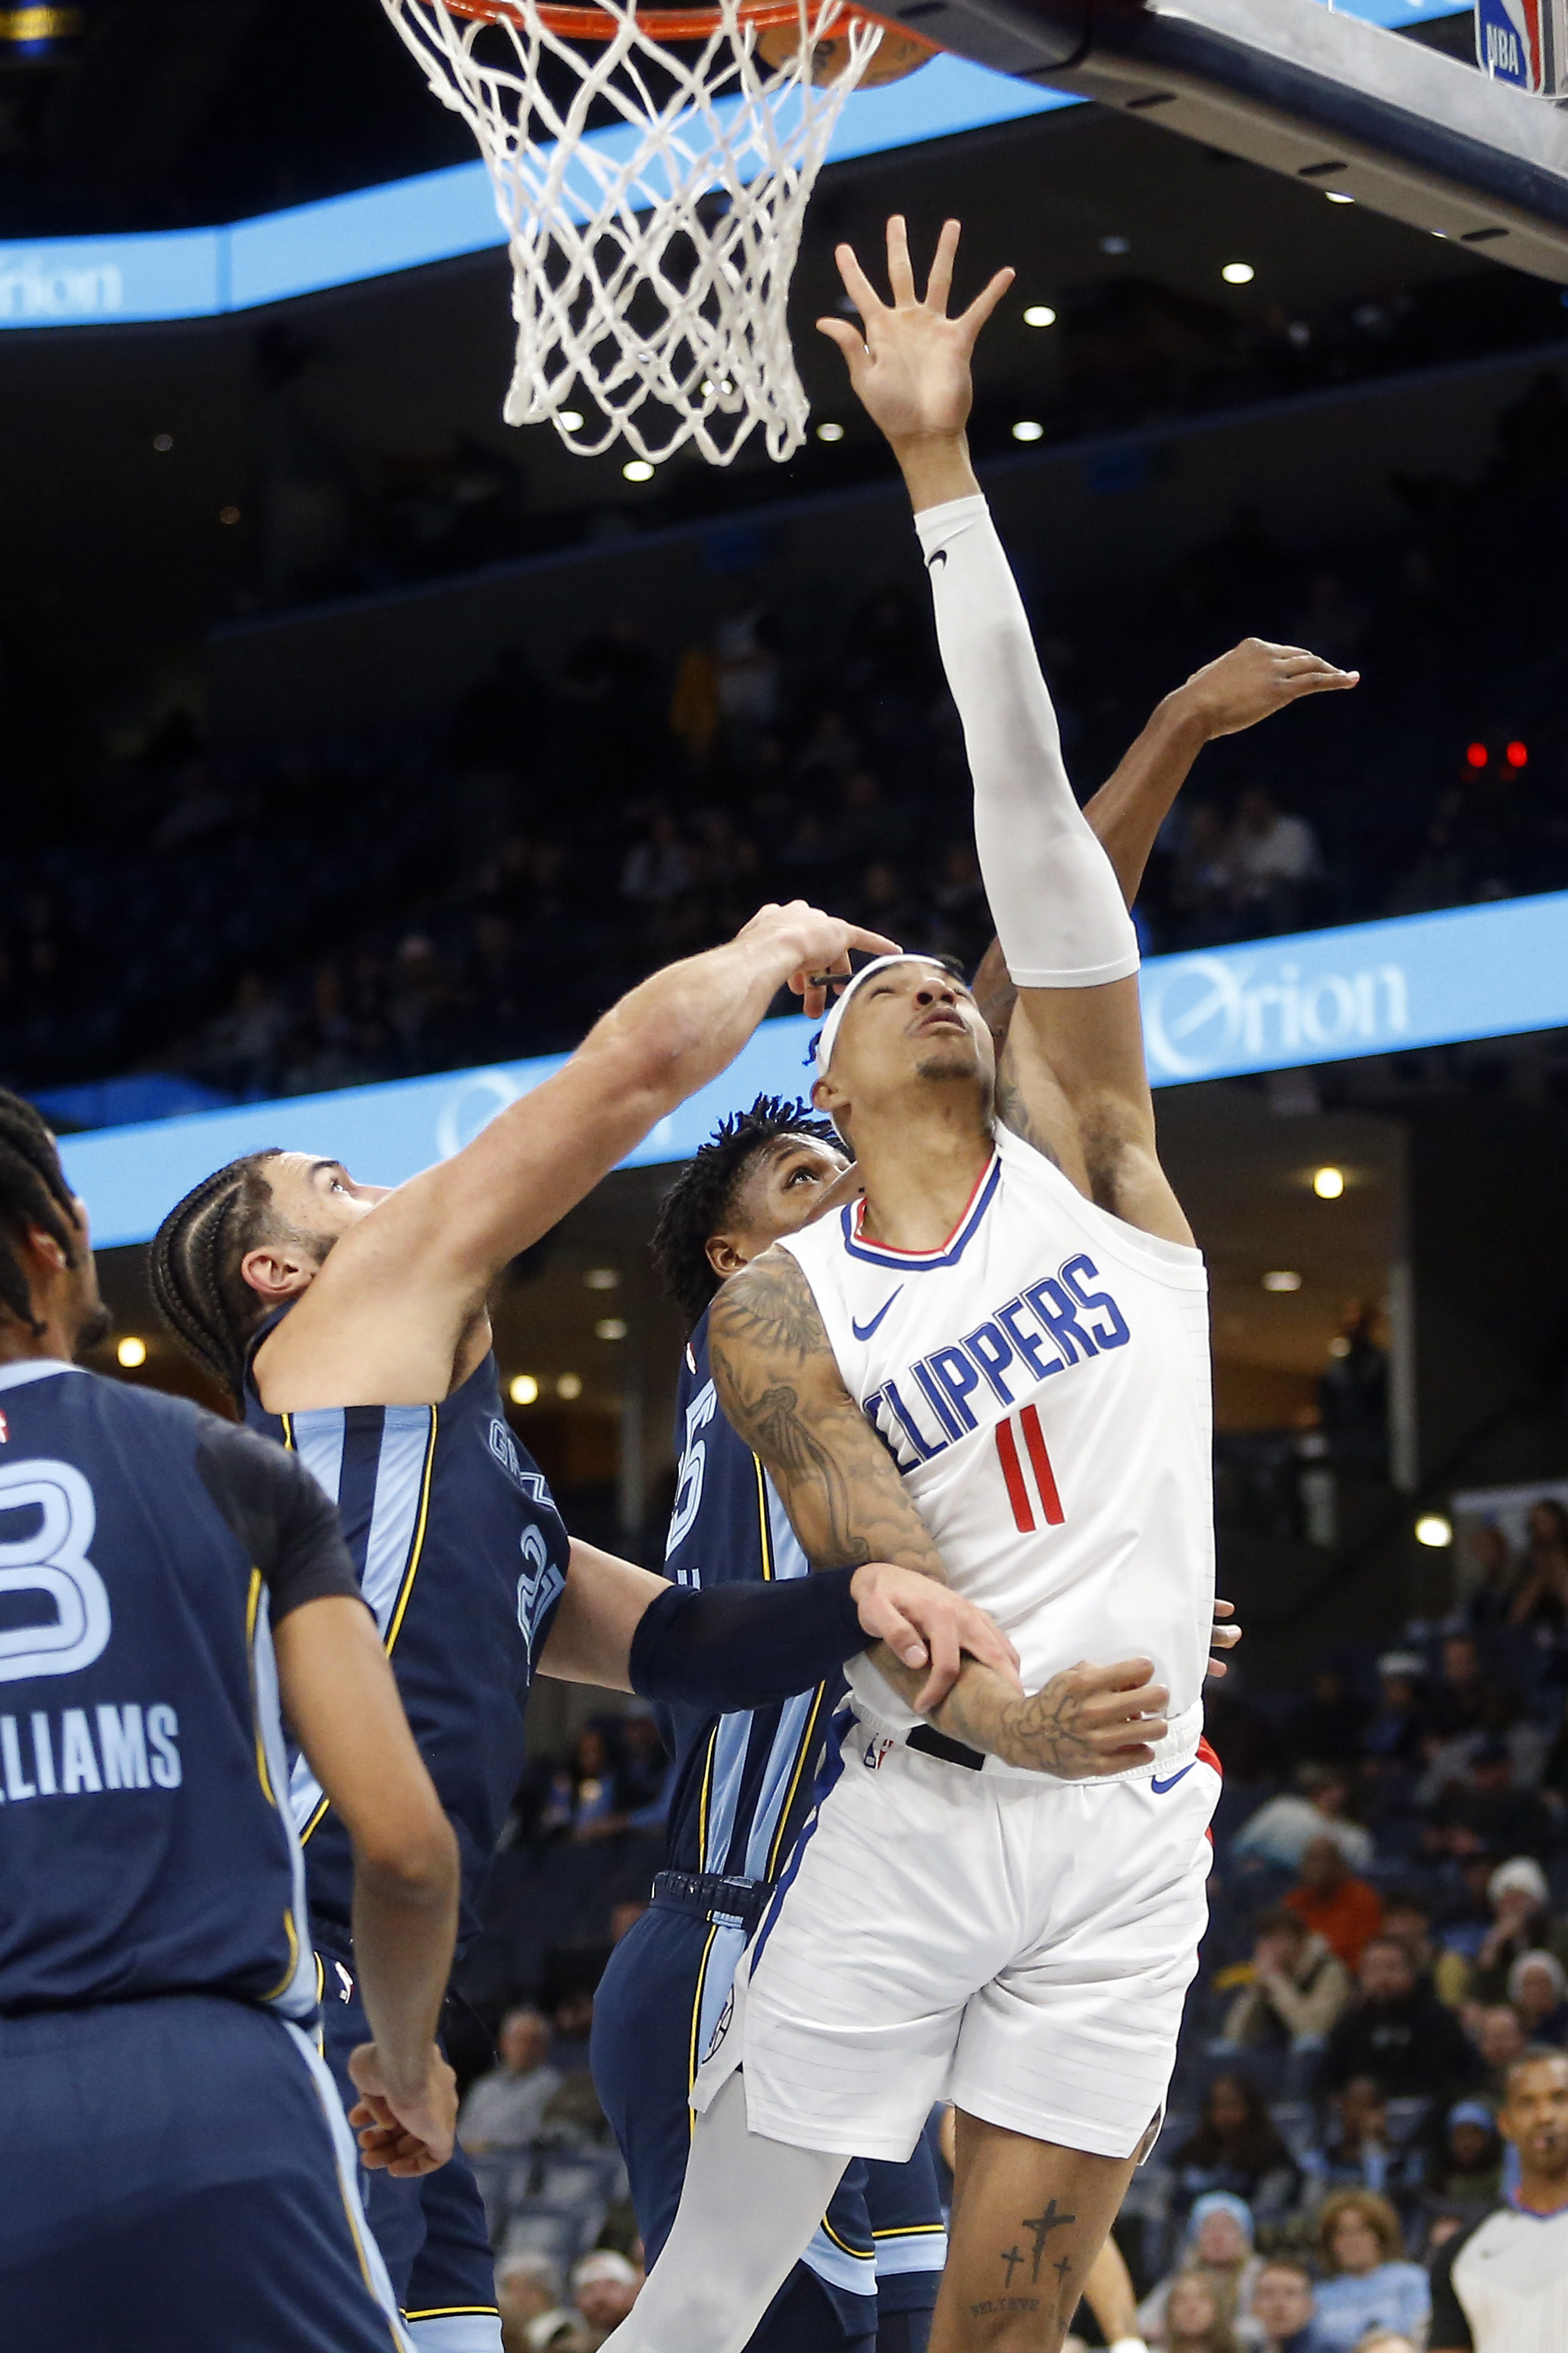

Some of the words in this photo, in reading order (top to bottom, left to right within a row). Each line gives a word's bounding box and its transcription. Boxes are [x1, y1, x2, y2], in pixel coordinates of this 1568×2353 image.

[1486, 23, 1519, 76] NBA
[862, 1253, 1131, 1477] CLIPPERS
[994, 1403, 1066, 1534] 11
[0, 1701, 183, 1804] LIAMS
